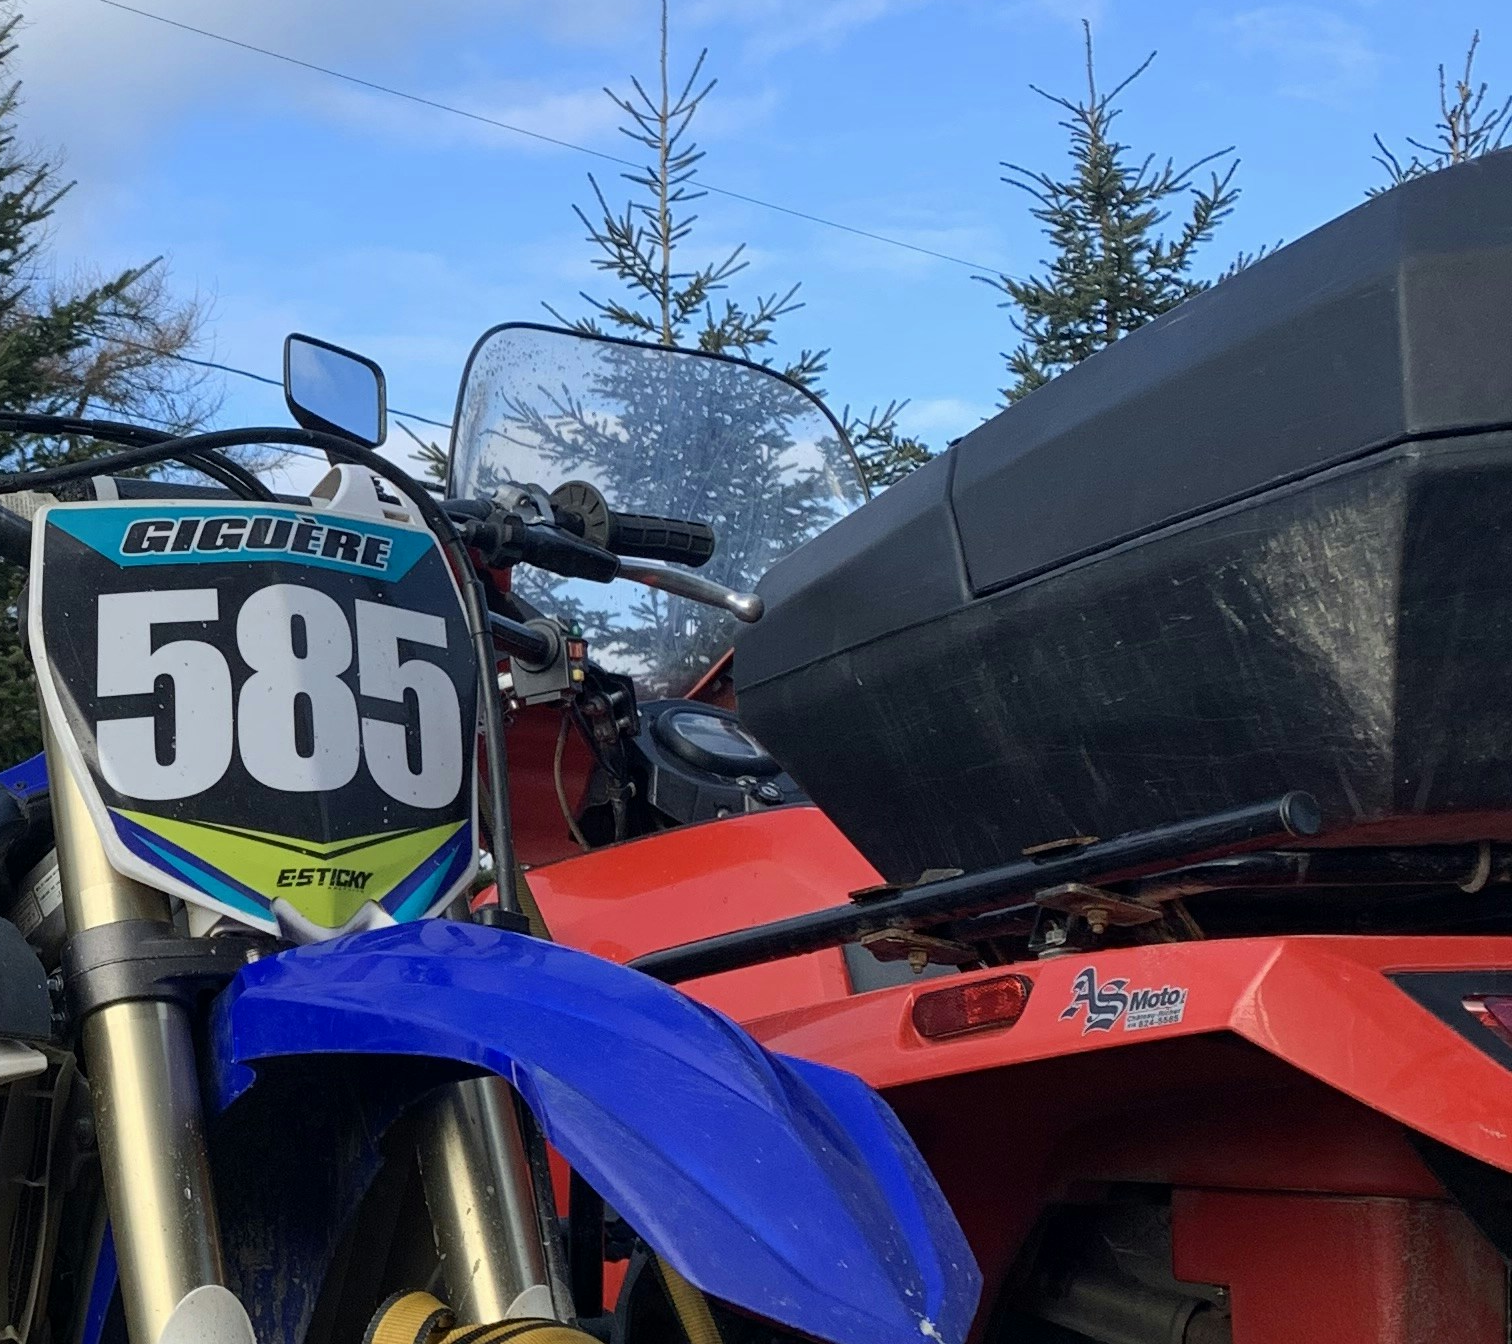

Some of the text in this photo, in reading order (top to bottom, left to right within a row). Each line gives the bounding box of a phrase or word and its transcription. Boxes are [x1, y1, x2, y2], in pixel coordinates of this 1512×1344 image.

[120, 512, 393, 571] GIGUÈRE
[96, 583, 463, 809] 585
[1058, 966, 1181, 1036] AS Moto
